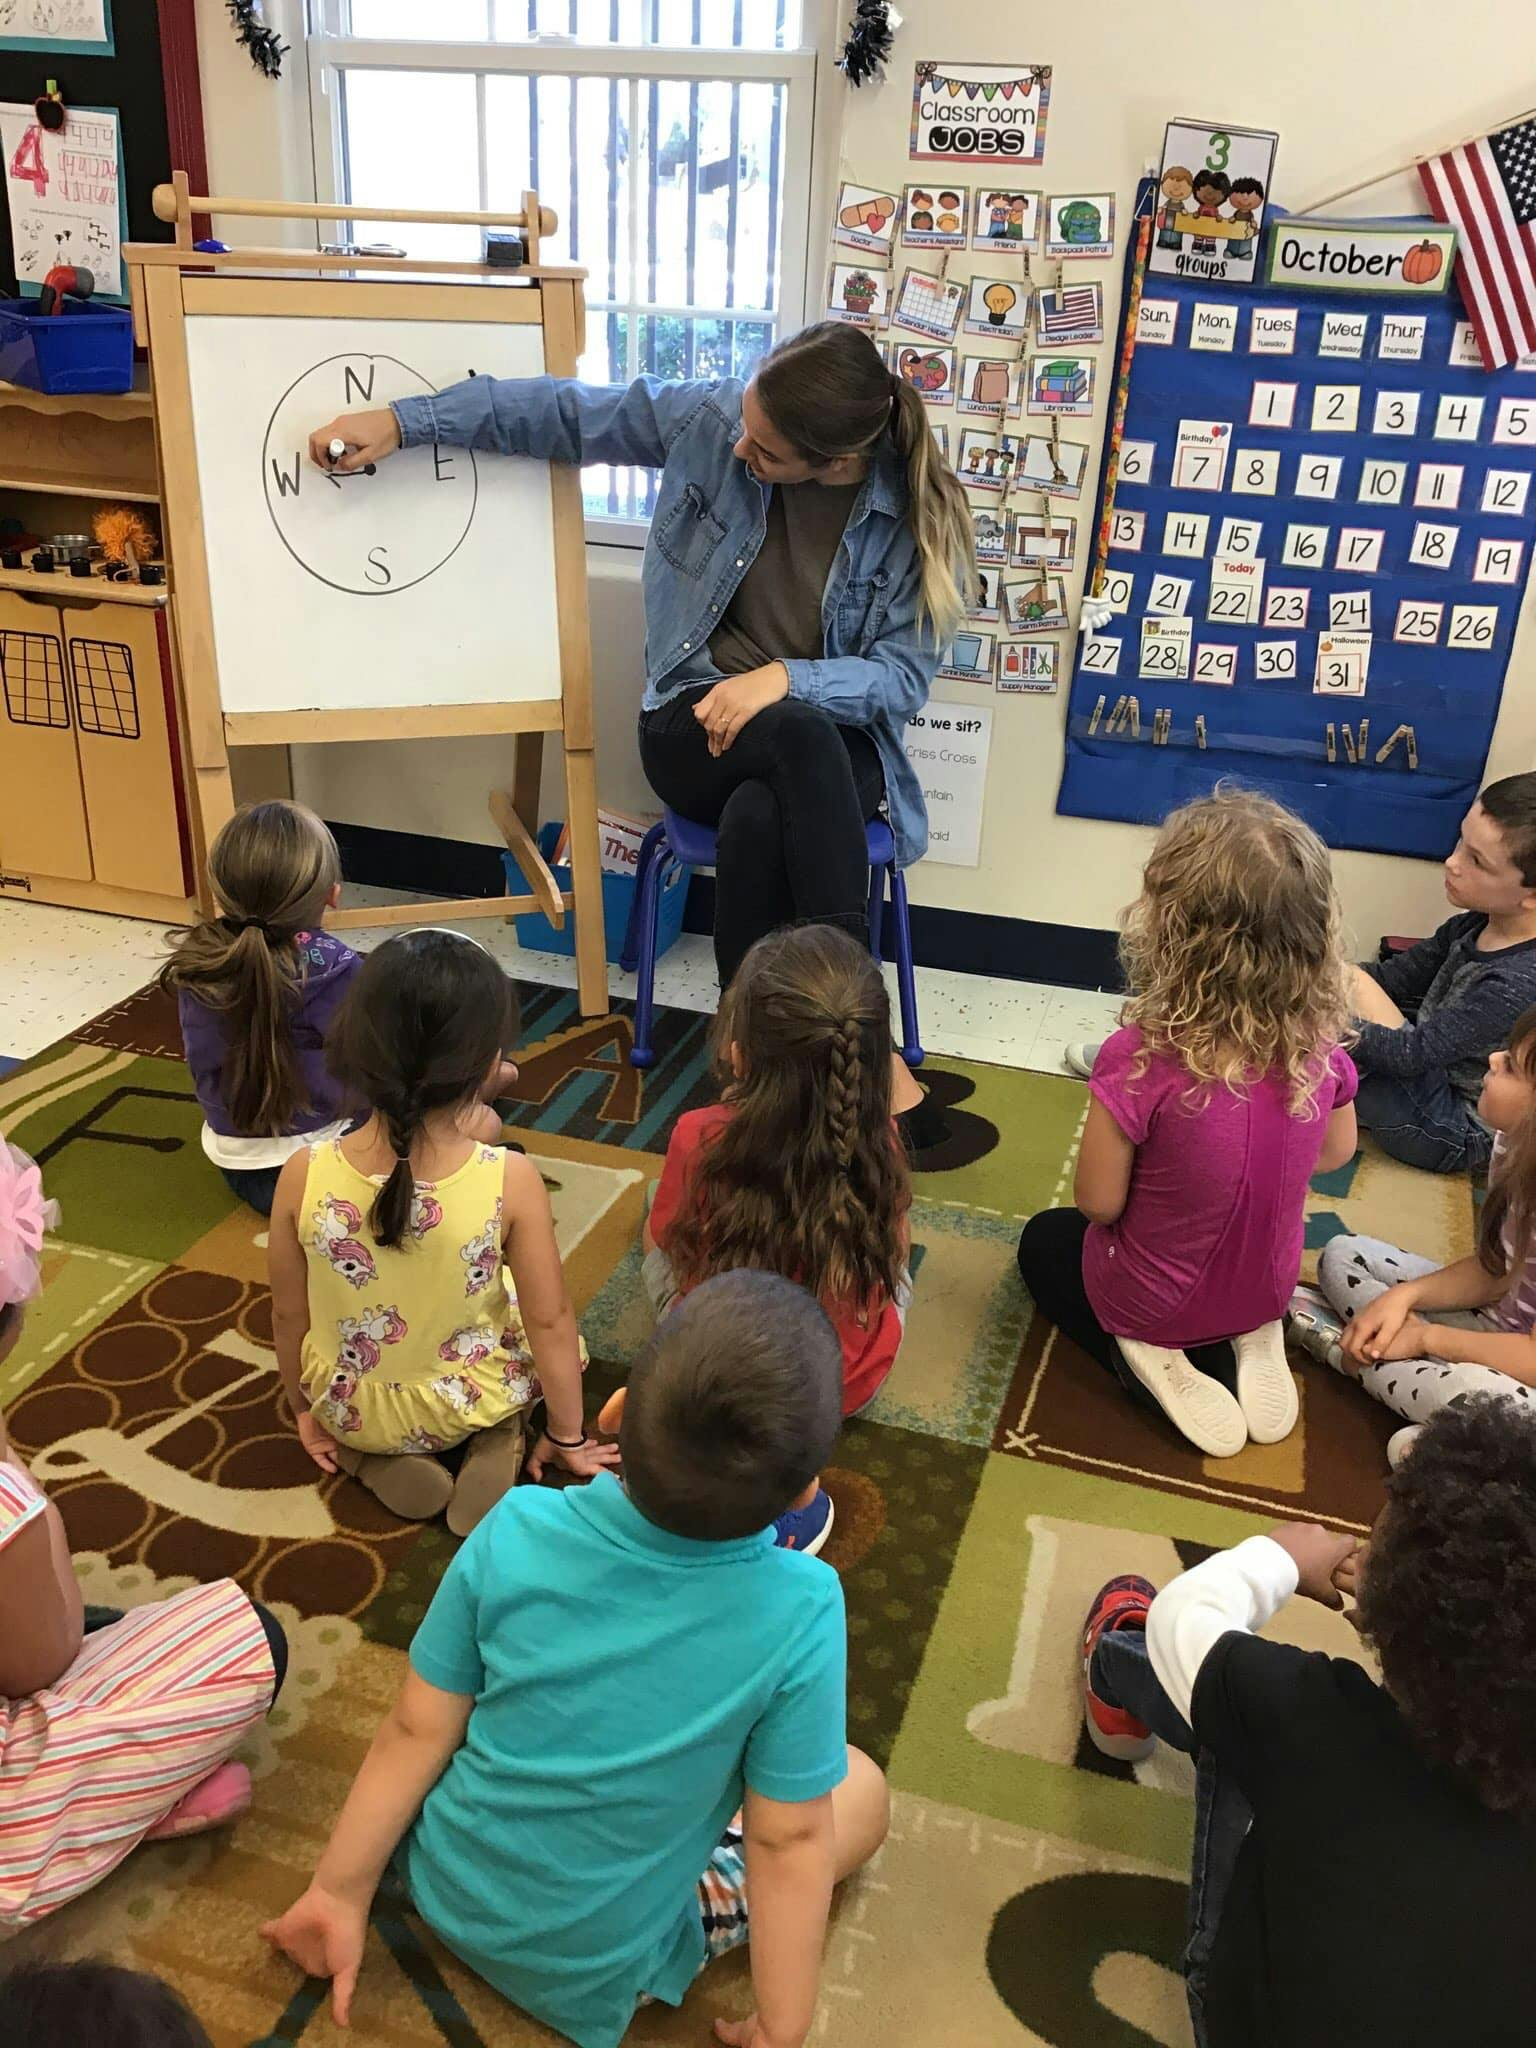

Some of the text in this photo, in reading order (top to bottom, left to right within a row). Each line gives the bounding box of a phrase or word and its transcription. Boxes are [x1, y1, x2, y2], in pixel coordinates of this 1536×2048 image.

[920, 101, 1036, 125] Classroom
[929, 126, 1025, 155] JOBS
[1205, 132, 1231, 171] 3
[10, 124, 49, 198] 4
[851, 235, 872, 246] Doctor
[994, 241, 1017, 249] Friend
[1051, 245, 1107, 254] Backpack Patrol
[1175, 252, 1228, 279] groups
[1281, 239, 1403, 275] October
[841, 313, 871, 322] Gardene
[1140, 307, 1171, 324] Sun.
[1198, 312, 1232, 329] Mon.
[1256, 316, 1295, 332] Tues.
[1045, 332, 1095, 342] Pledge Leader
[1140, 330, 1167, 340] Sunday
[1198, 335, 1226, 345] Monday
[1327, 321, 1364, 337] Wed.
[1383, 323, 1424, 339] Thur.
[1257, 340, 1288, 348] Tuesday
[1383, 346, 1418, 355] Thursday
[344, 364, 375, 404] N
[967, 403, 988, 412] Lunch
[1043, 404, 1076, 413] Librarian
[1267, 390, 1275, 418] 1
[1326, 393, 1345, 421] 2
[1386, 401, 1405, 429] 3
[1448, 403, 1467, 432] 4
[1508, 407, 1530, 436] 5
[1180, 433, 1214, 444] Birthday
[272, 451, 301, 497] W
[1123, 449, 1141, 475] 6
[1192, 456, 1210, 483] 7
[1247, 459, 1264, 486] 8
[1310, 464, 1330, 492] 9
[1370, 468, 1397, 496] 10
[1431, 473, 1445, 500] 11
[1492, 478, 1518, 507] 12
[1113, 514, 1135, 541] 13
[1173, 521, 1197, 549] 14
[1226, 525, 1252, 552] 15
[1293, 532, 1317, 560] 16
[1348, 536, 1374, 563] 17
[1420, 530, 1446, 559] 18
[364, 546, 391, 585] S
[1224, 563, 1255, 575] Today
[1484, 547, 1511, 575] 19
[1155, 583, 1182, 610] 21
[1211, 591, 1246, 617] 22
[1269, 596, 1304, 621] 23
[1332, 598, 1367, 626] 24
[1400, 610, 1439, 637] 25
[1161, 628, 1190, 637] Birthday
[1331, 636, 1370, 646] Halloween
[1454, 615, 1491, 641] 26
[1084, 643, 1119, 669] 27
[1143, 645, 1177, 670] 28
[1197, 651, 1234, 677] 29
[1259, 648, 1295, 673] 30
[1001, 683, 1052, 692] Supply Manager
[1327, 662, 1349, 687] 31
[909, 714, 982, 734] do we sit?
[905, 745, 977, 765] Criss Cross
[605, 836, 641, 864] The
